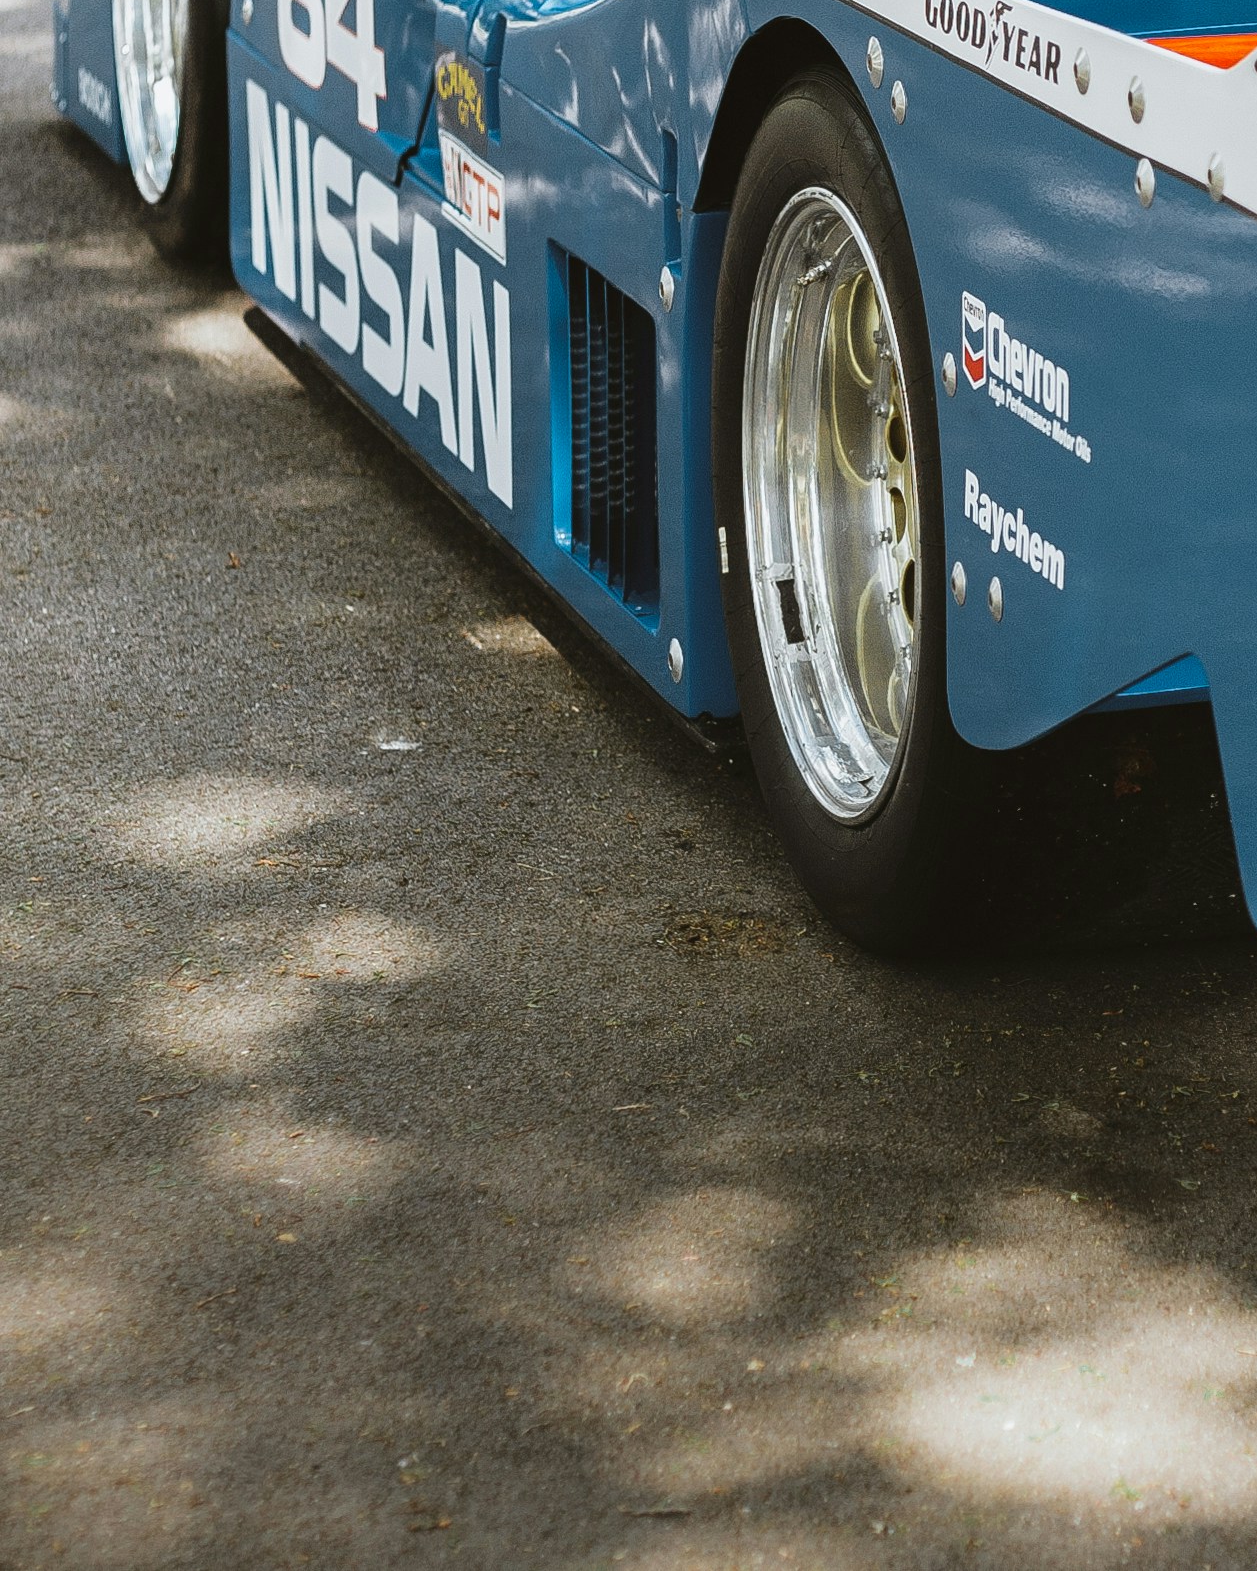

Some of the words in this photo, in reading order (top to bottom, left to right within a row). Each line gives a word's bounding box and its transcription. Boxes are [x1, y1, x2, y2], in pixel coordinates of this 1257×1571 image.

[436, 61, 485, 134] CAMEL
[463, 160, 501, 233] GTP
[246, 78, 514, 510] NISSAN
[963, 296, 985, 322] Chevron
[988, 312, 1069, 423] Chevron
[989, 376, 1005, 407] High
[1005, 388, 1052, 437] Performance
[1052, 419, 1075, 452] Motor
[1075, 435, 1092, 464] Oils
[964, 468, 1065, 591] Raychem
